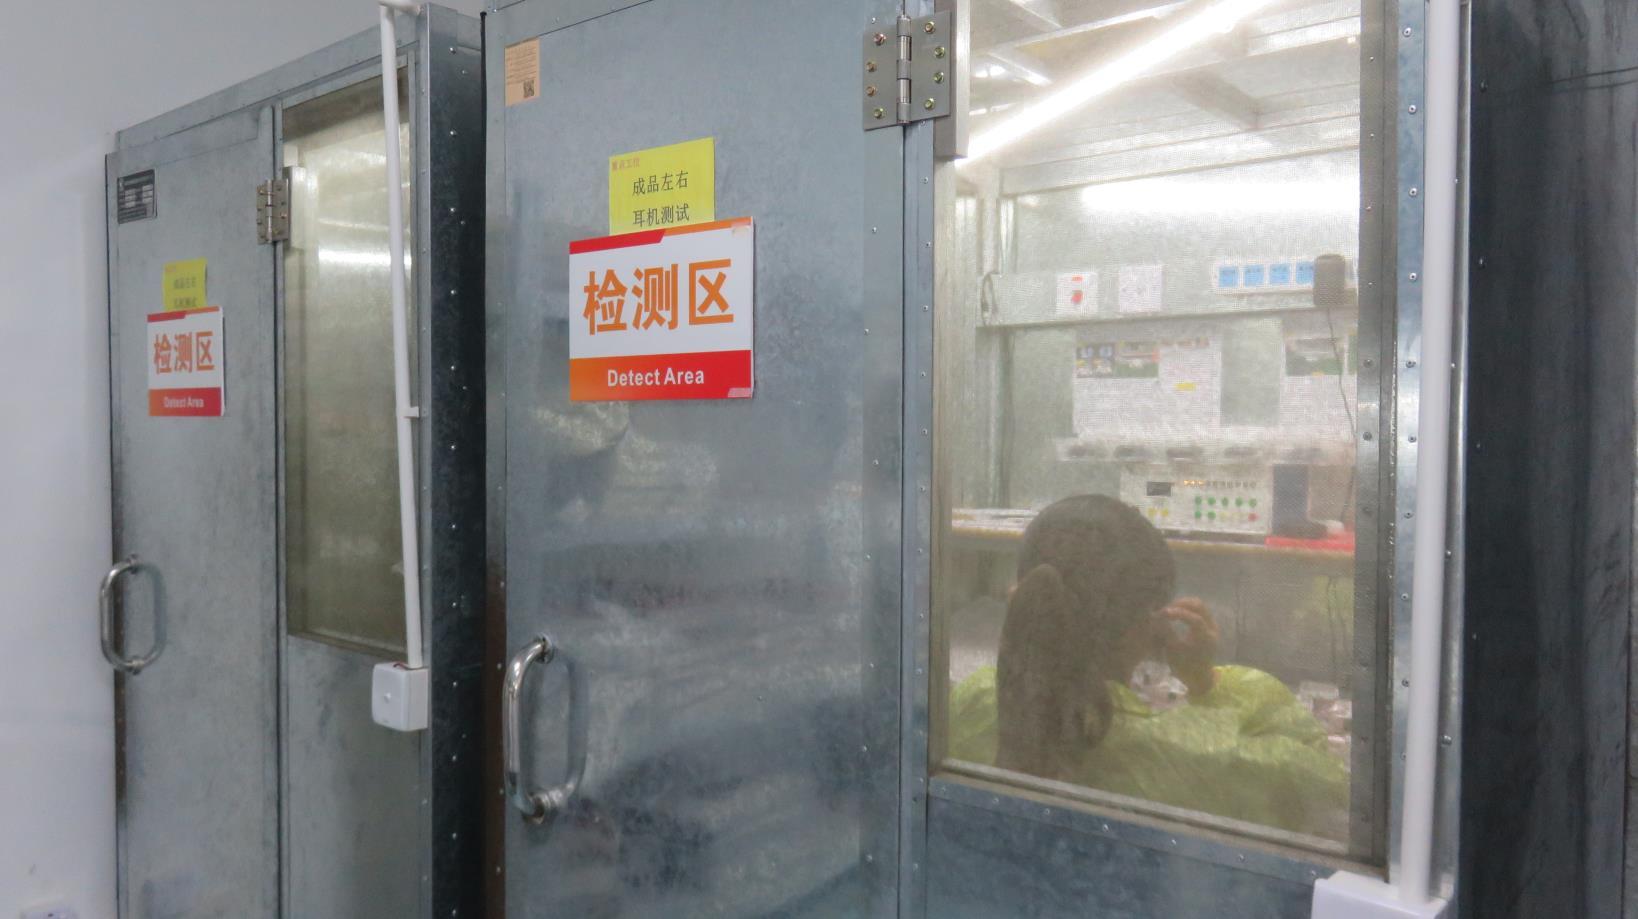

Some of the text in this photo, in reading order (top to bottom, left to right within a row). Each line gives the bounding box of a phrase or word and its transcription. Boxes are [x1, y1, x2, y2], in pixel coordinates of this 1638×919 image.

[632, 170, 689, 196] 成品左右
[633, 202, 690, 227] 耳机测试
[582, 258, 734, 336] 检测区
[154, 331, 215, 375] 检测区
[607, 367, 705, 387] Detect Area
[187, 395, 205, 409] Area
